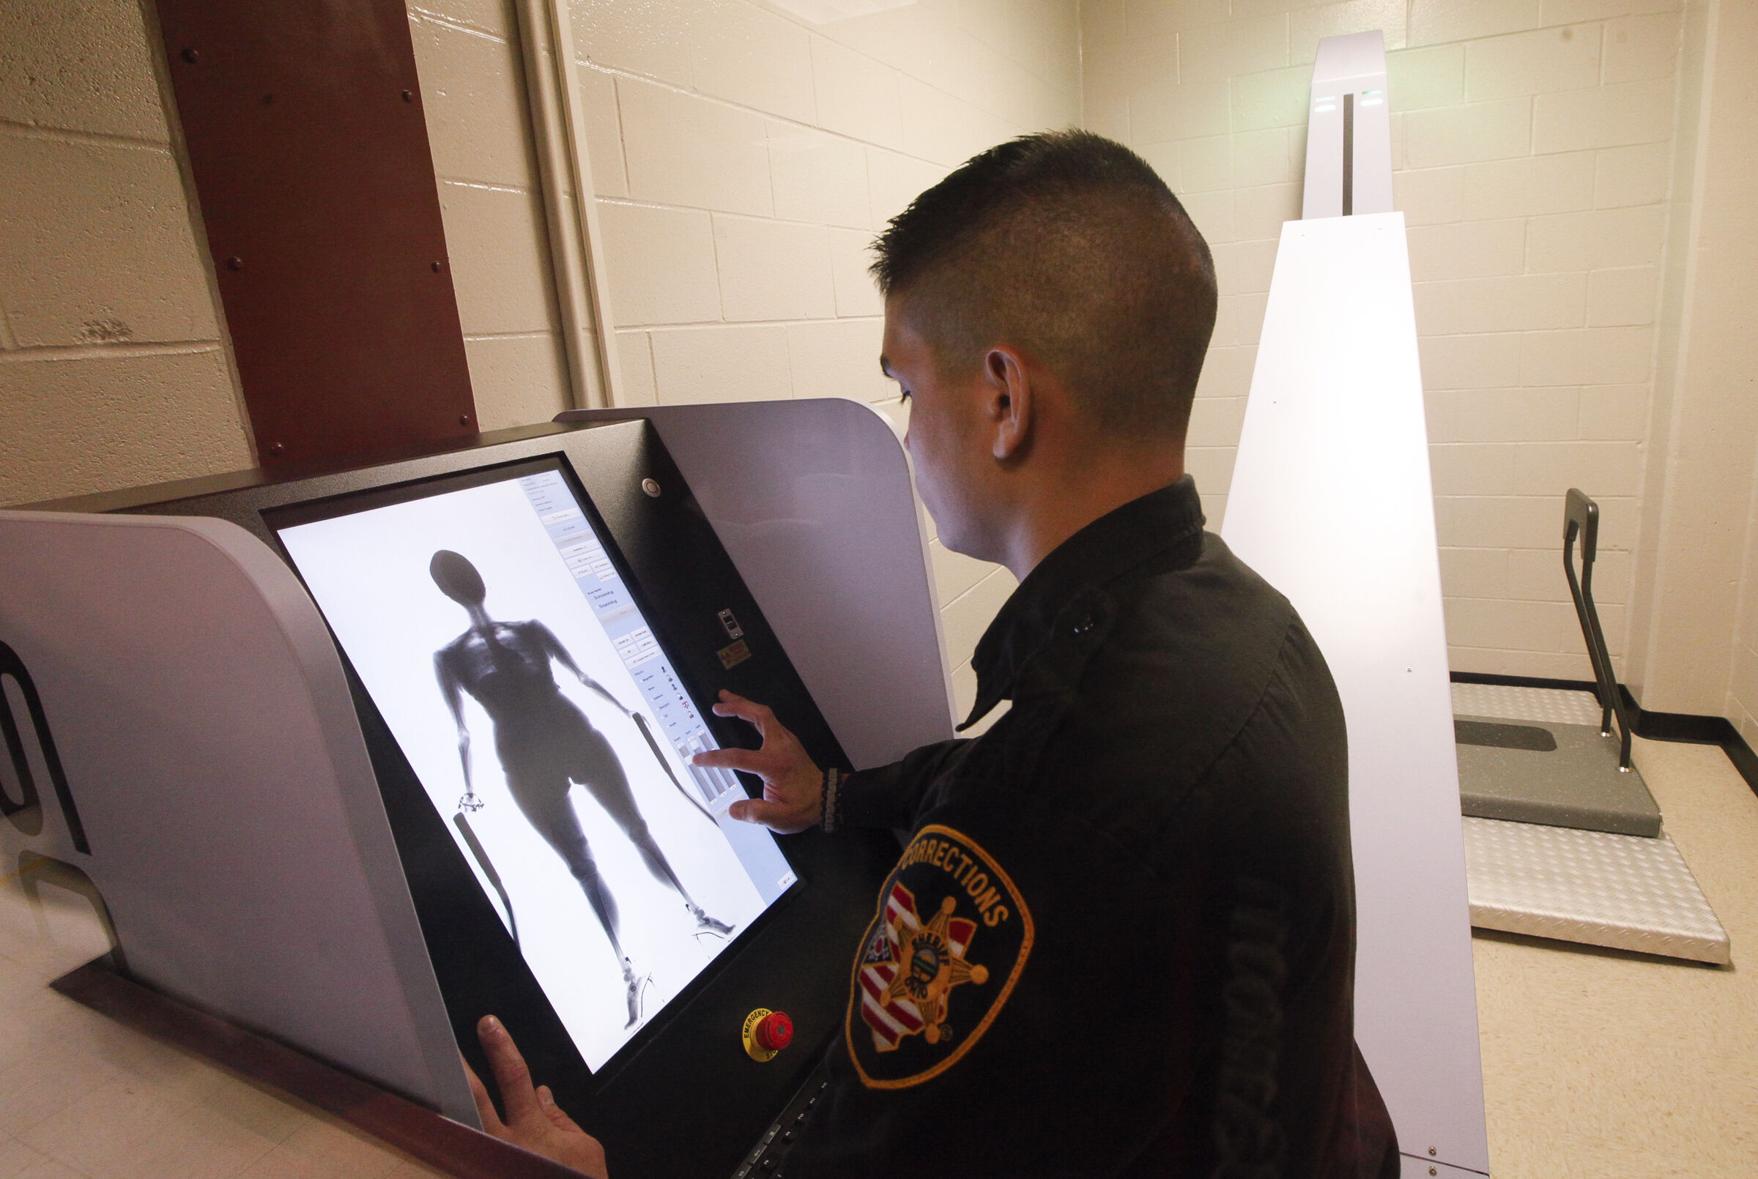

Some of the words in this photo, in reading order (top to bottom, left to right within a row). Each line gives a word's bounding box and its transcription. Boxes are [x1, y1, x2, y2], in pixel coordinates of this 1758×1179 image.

[902, 839, 1009, 927] CORRECTIONS
[912, 932, 950, 966] SHERIFF
[905, 976, 929, 999] OHIO
[744, 1010, 769, 1039] EMERGENCY
